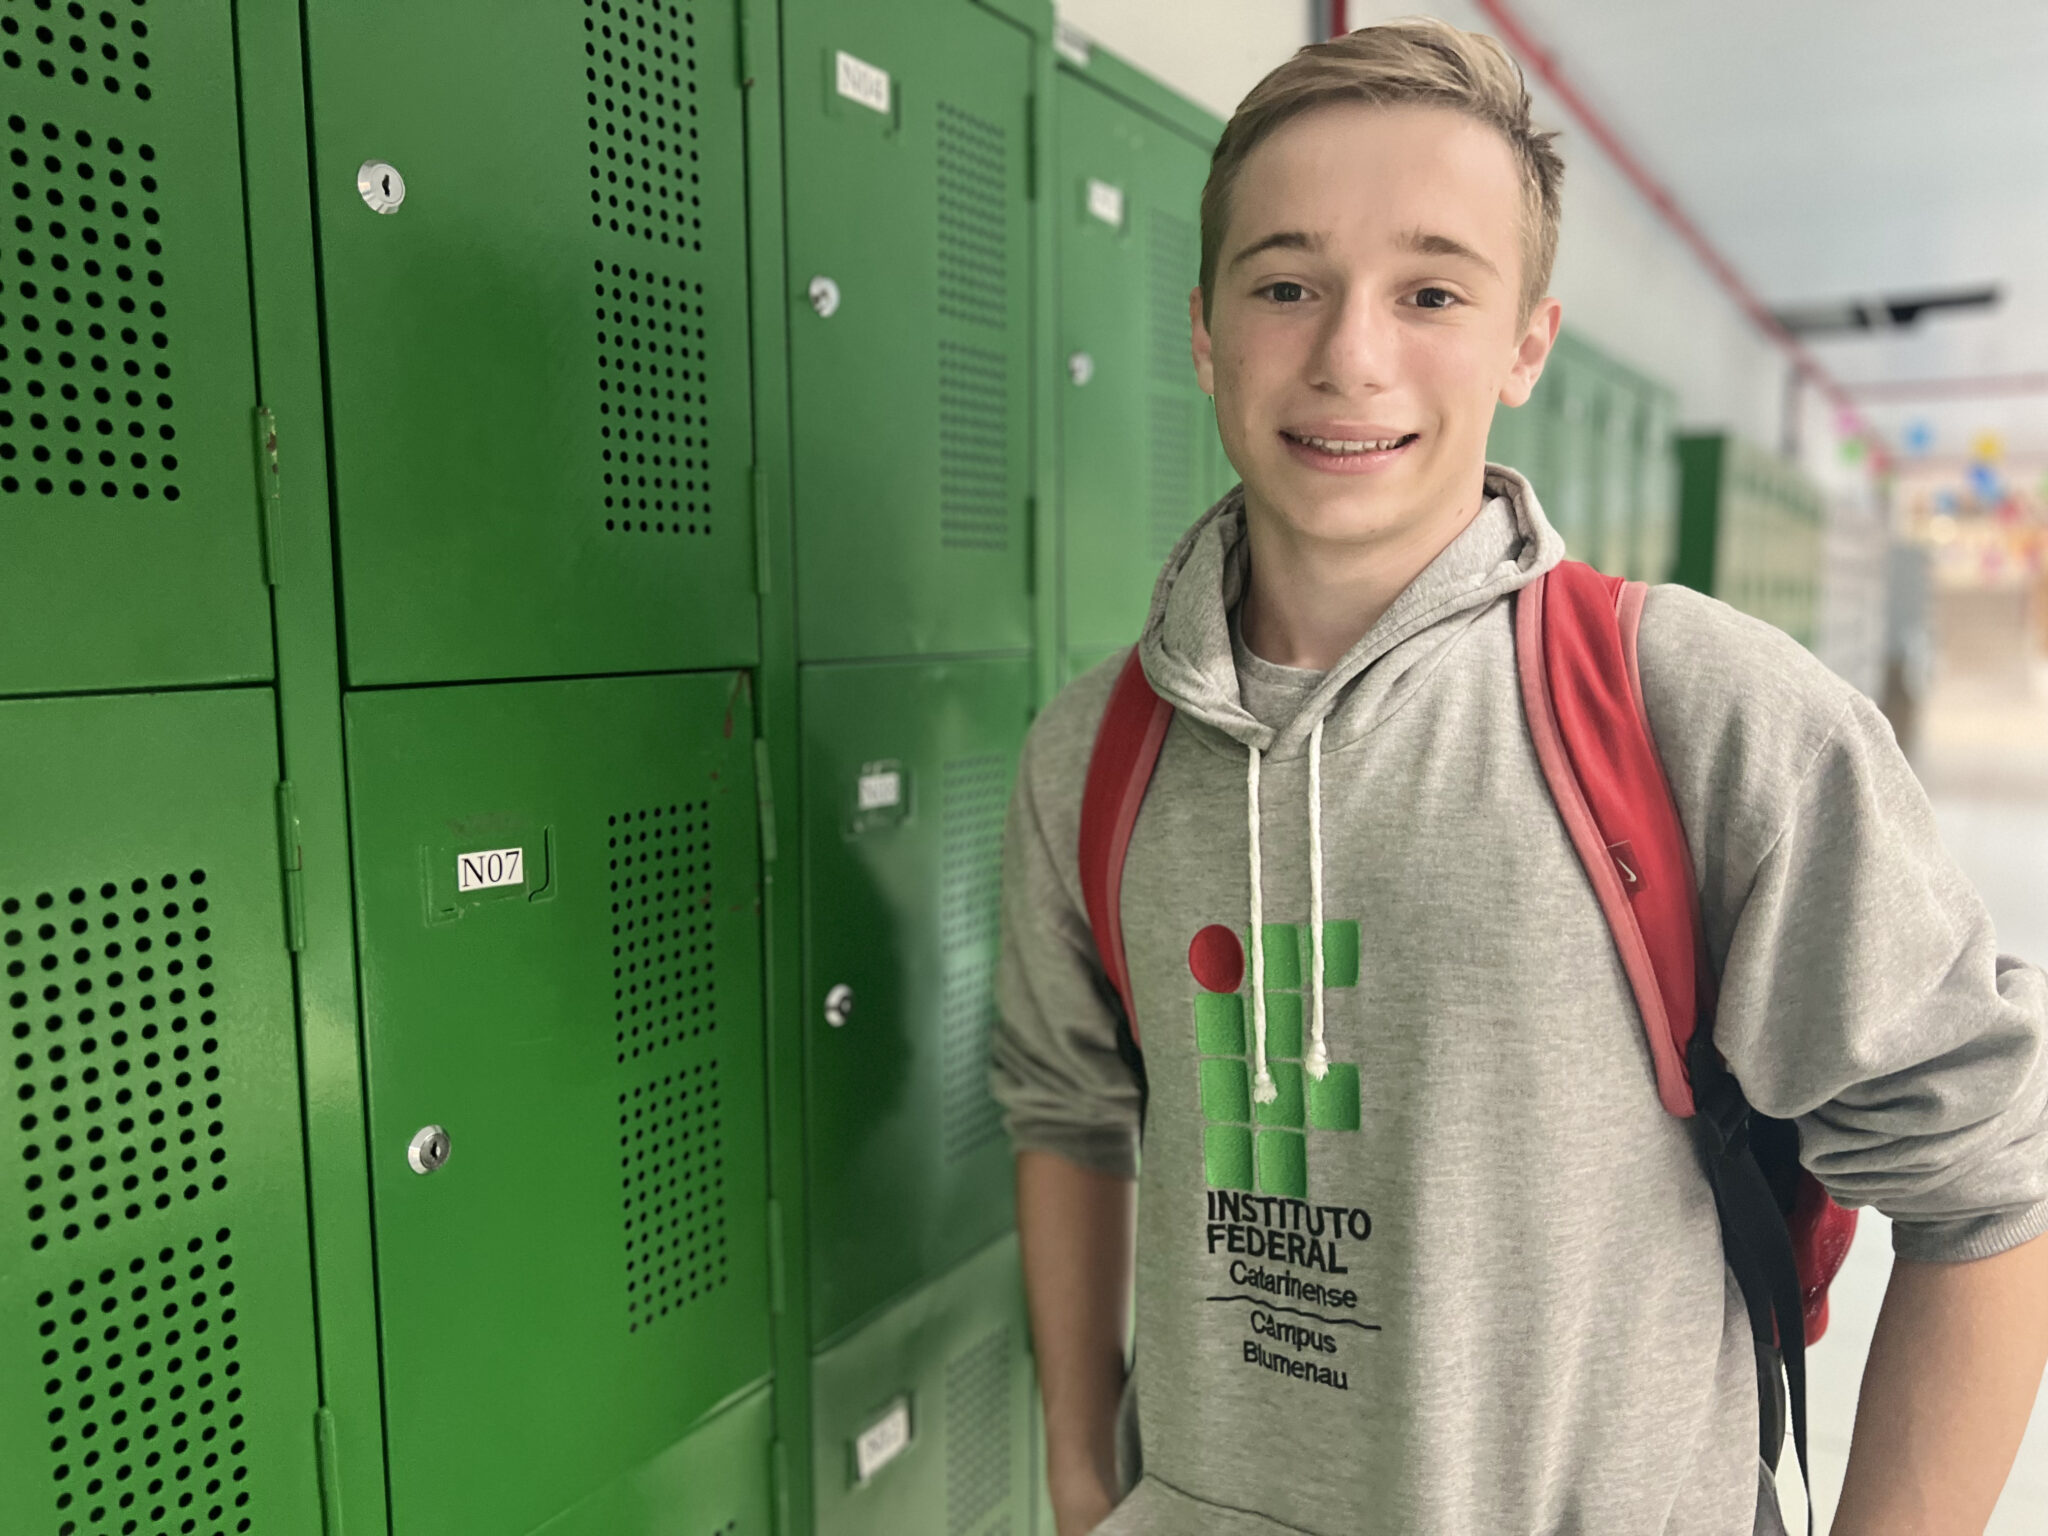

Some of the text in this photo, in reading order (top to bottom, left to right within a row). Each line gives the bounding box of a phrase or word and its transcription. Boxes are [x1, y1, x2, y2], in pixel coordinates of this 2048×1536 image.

[461, 850, 520, 887] N07
[1207, 1190, 1372, 1241] INSTITUTO
[1207, 1223, 1348, 1274] FEDERAL
[1229, 1260, 1358, 1308] Catarinense
[1250, 1310, 1337, 1353] Câmpus
[1243, 1340, 1348, 1390] Blumenau
